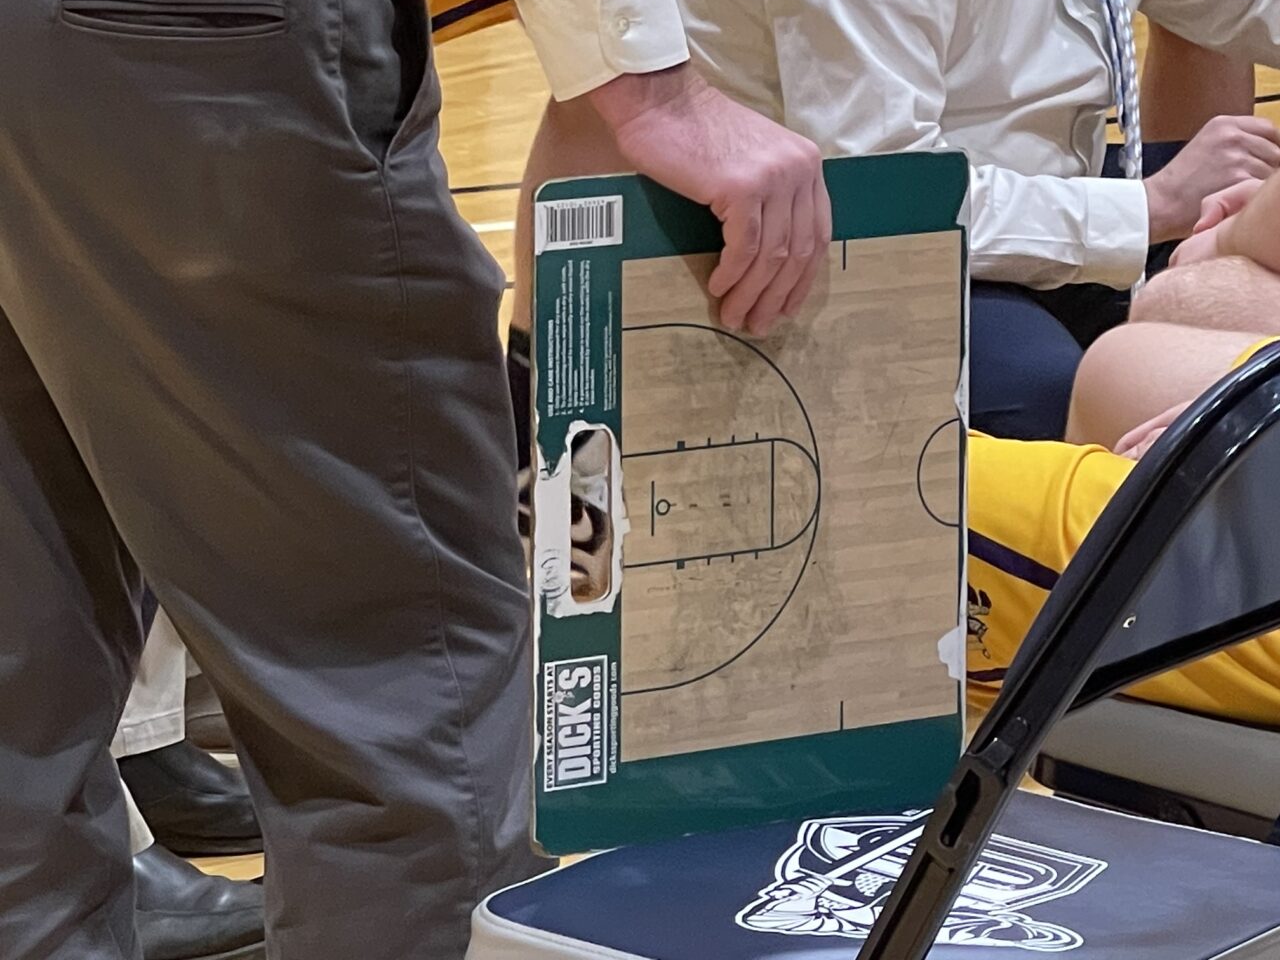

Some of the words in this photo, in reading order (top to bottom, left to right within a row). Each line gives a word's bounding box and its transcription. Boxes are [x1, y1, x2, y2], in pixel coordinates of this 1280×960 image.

[546, 665, 553, 677] AT
[592, 665, 601, 709] GOODS
[554, 666, 592, 781] DICK'S
[592, 712, 601, 774] SPORTING
